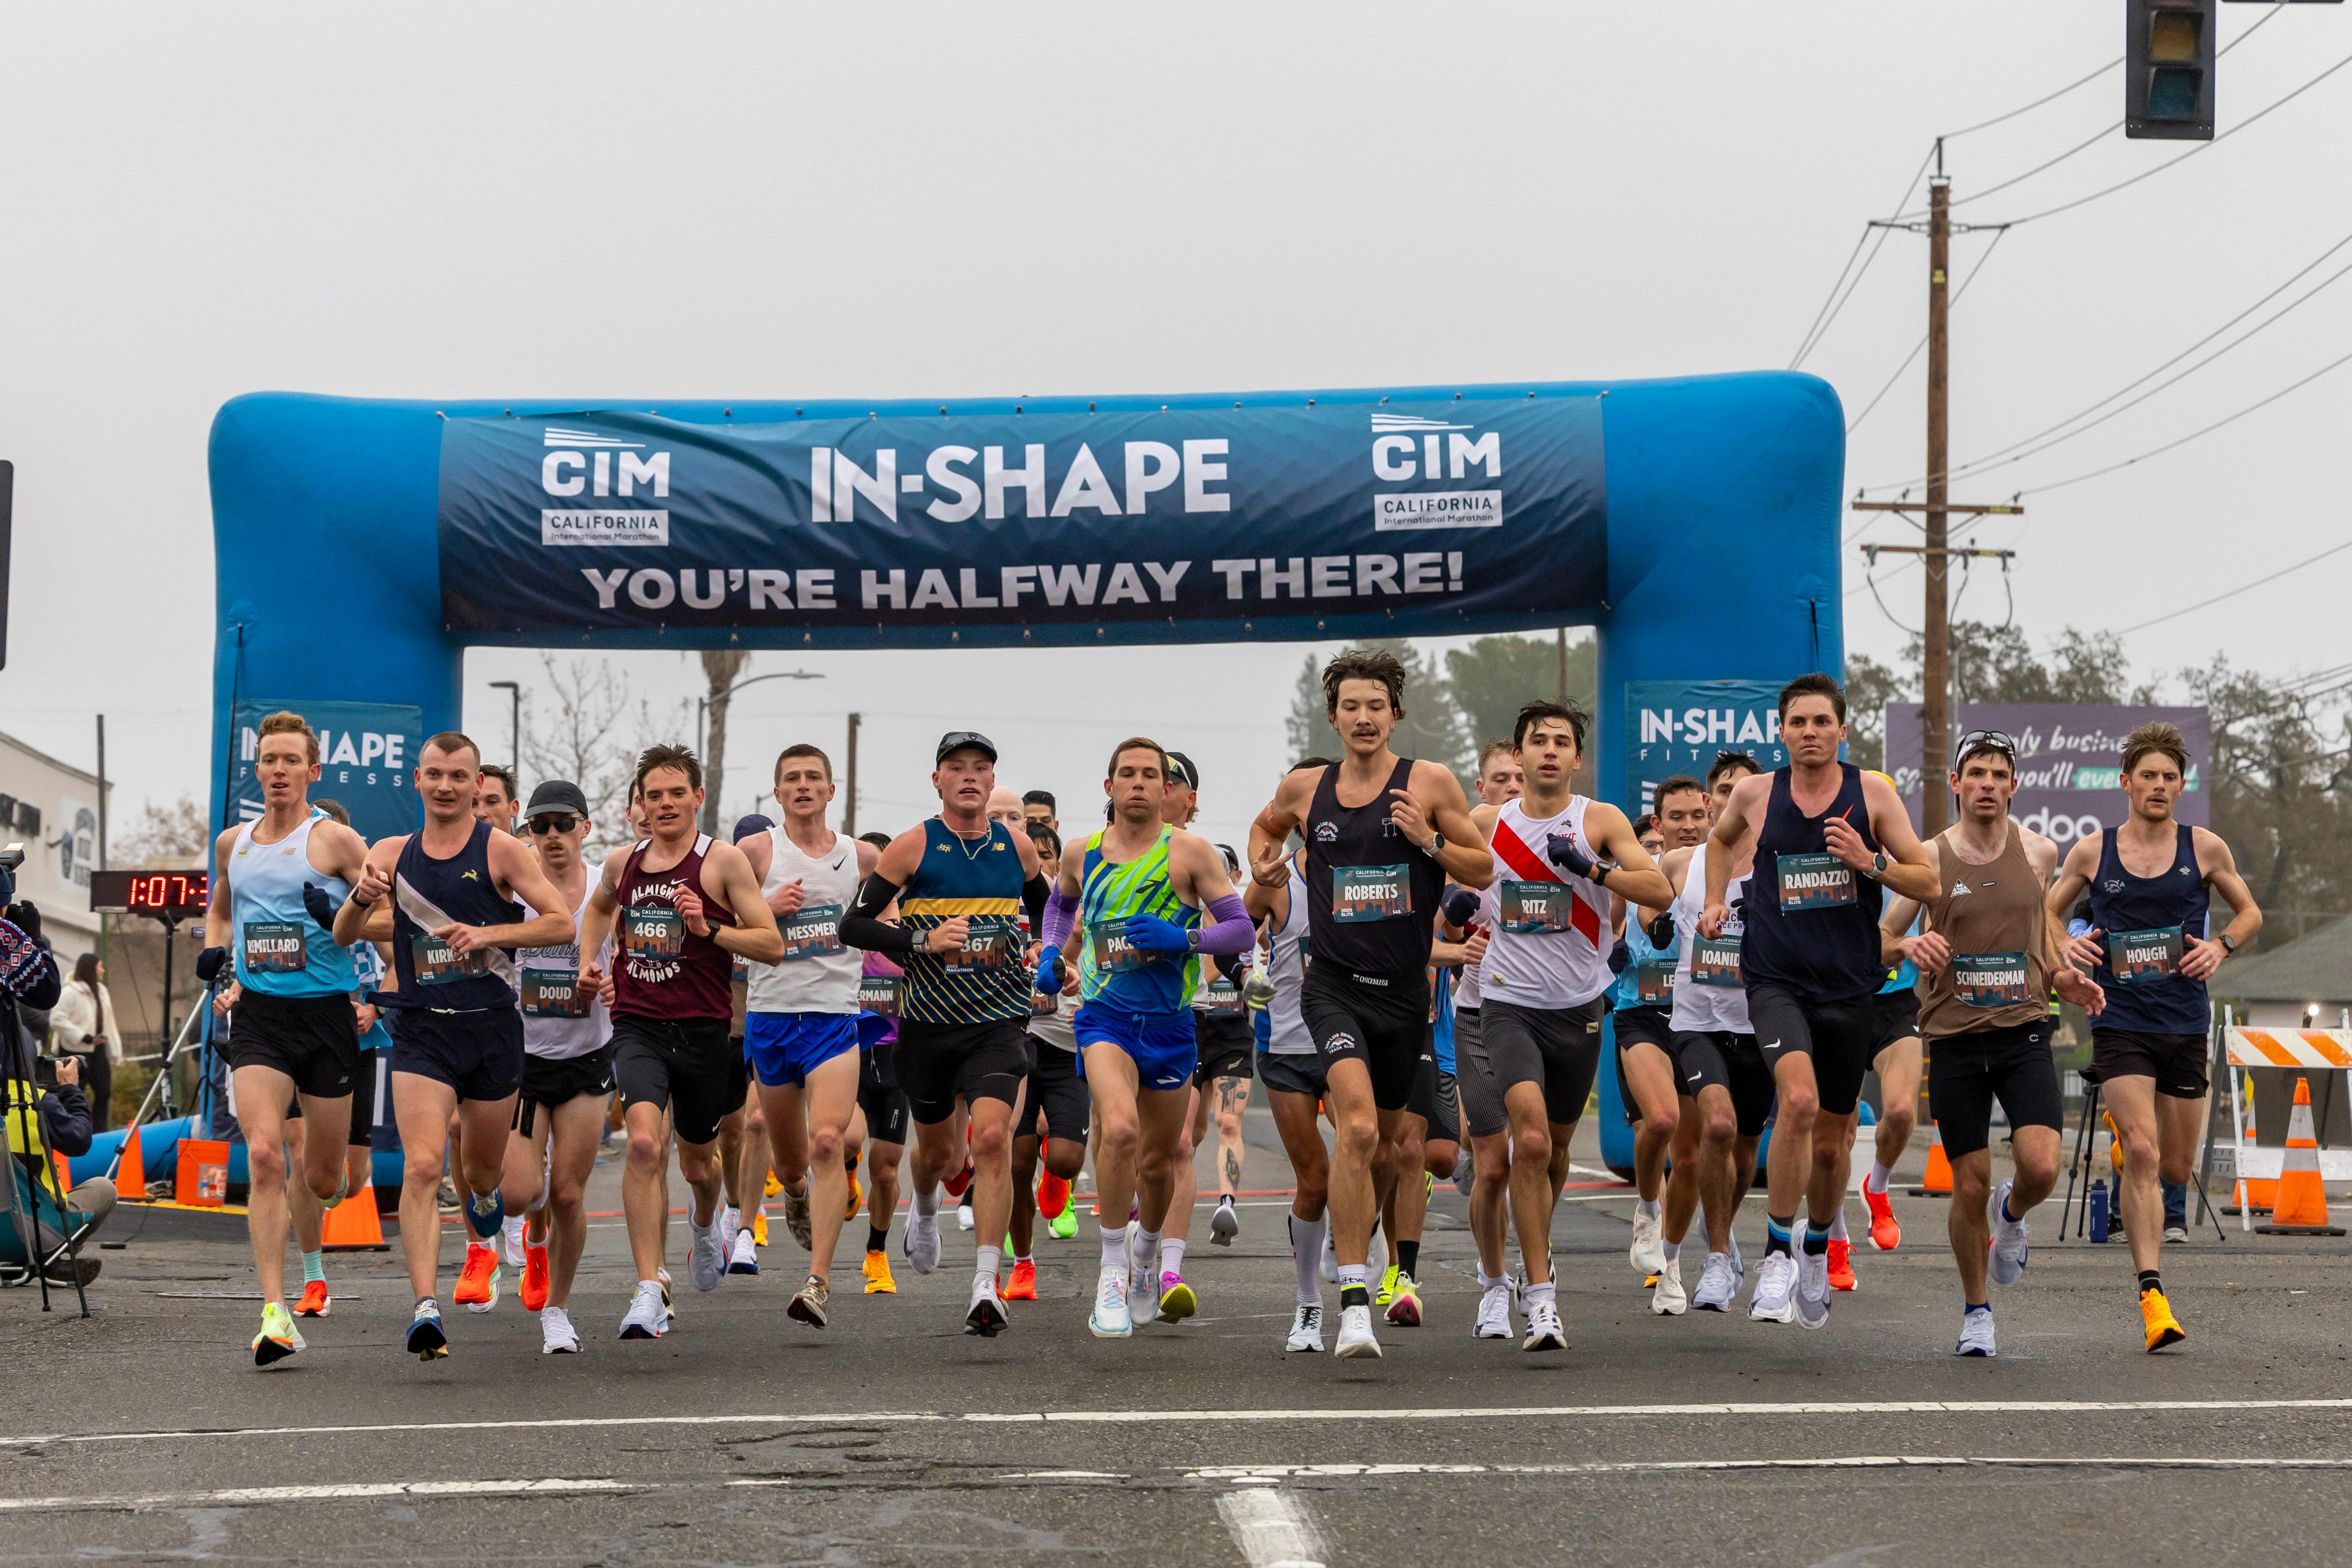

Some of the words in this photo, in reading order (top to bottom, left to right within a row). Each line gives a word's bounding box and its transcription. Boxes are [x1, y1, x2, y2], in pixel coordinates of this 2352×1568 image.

[1372, 432, 1501, 481] CIM
[542, 451, 670, 497] CIM
[811, 439, 1230, 523] IN-SHAPE
[1384, 497, 1493, 513] CALIFORNIA
[551, 516, 659, 529] CALIFORNIA
[1384, 515, 1445, 524] International
[1448, 514, 1493, 523] Marathon
[582, 568, 837, 610] YOU'RE
[861, 561, 1192, 609] HALFWAY
[1212, 551, 1464, 599] THERE!
[1641, 708, 1781, 744] IN-SHAP
[2011, 725, 2041, 758] nly
[2049, 725, 2128, 753] busine
[2009, 806, 2102, 843] doo
[1784, 869, 1850, 890] RANDAZZO
[631, 884, 680, 905] ALMIGH
[1344, 883, 1398, 901] ROBERTS
[1521, 899, 1547, 914] RITZ
[634, 922, 667, 938] 466
[787, 922, 837, 941] MESSMER
[2126, 946, 2168, 964] HOUGH
[626, 961, 680, 984] ALMONDS
[1359, 976, 1389, 987] CHICKNLEGS
[1956, 970, 2025, 987] SCHNEIDERMAN
[539, 986, 572, 1000] DOUD
